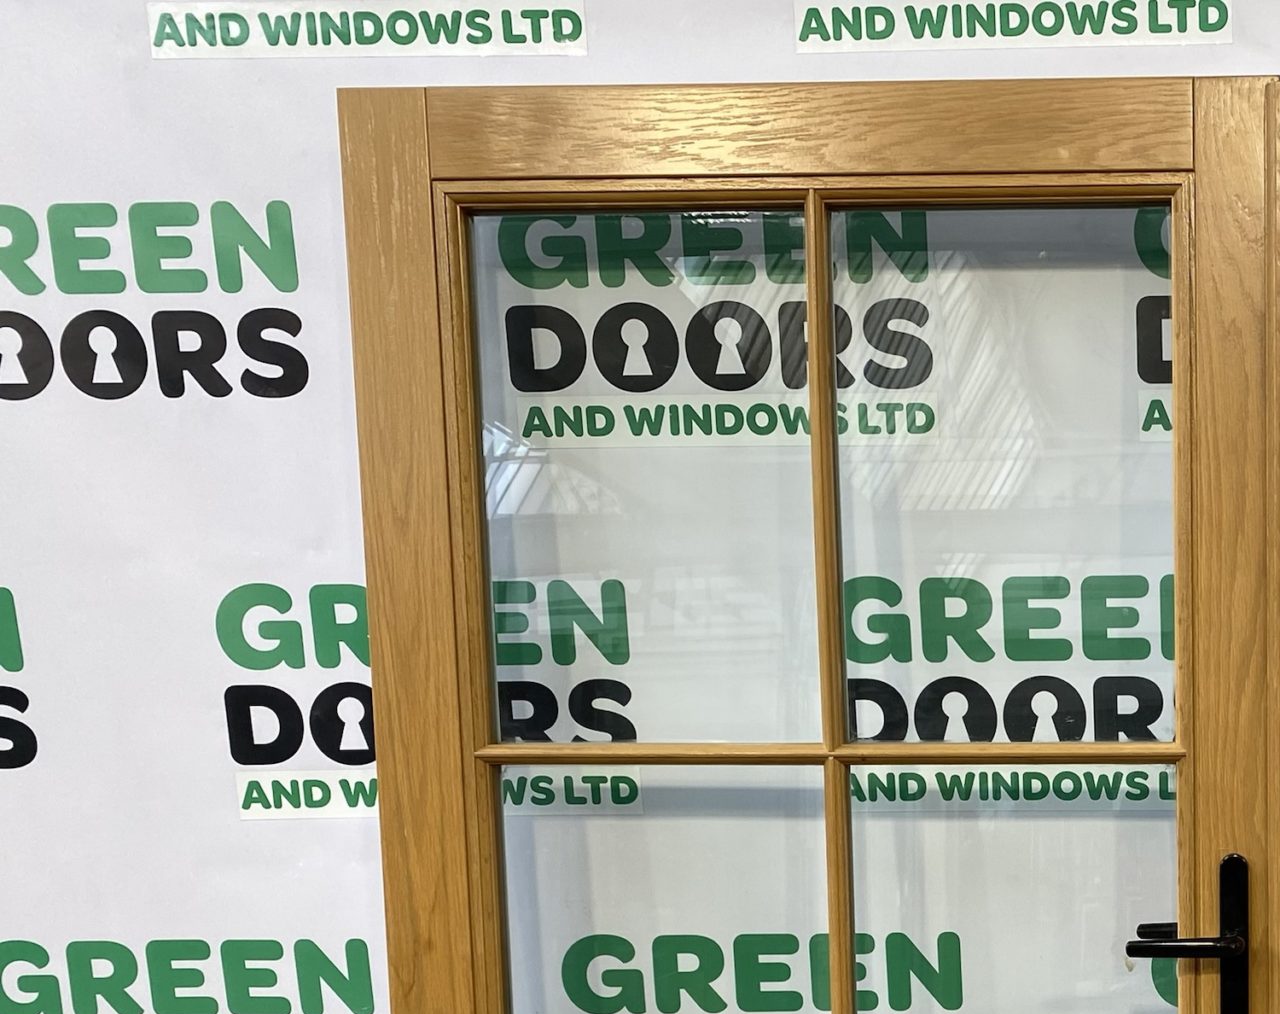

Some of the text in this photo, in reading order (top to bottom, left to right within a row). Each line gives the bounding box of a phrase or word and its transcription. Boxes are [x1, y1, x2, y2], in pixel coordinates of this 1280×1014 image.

[154, 9, 582, 48] AND WINDOWS LTD
[799, 0, 1228, 42] AND WINDOWS LTD
[505, 298, 933, 393] DOORS
[522, 405, 615, 438] AND
[858, 402, 935, 435] LTD
[843, 575, 1175, 664] GREE
[848, 675, 1174, 742] DOOR
[241, 780, 332, 810] AND
[564, 775, 639, 805] LTD
[935, 771, 1149, 801] WINDOWS
